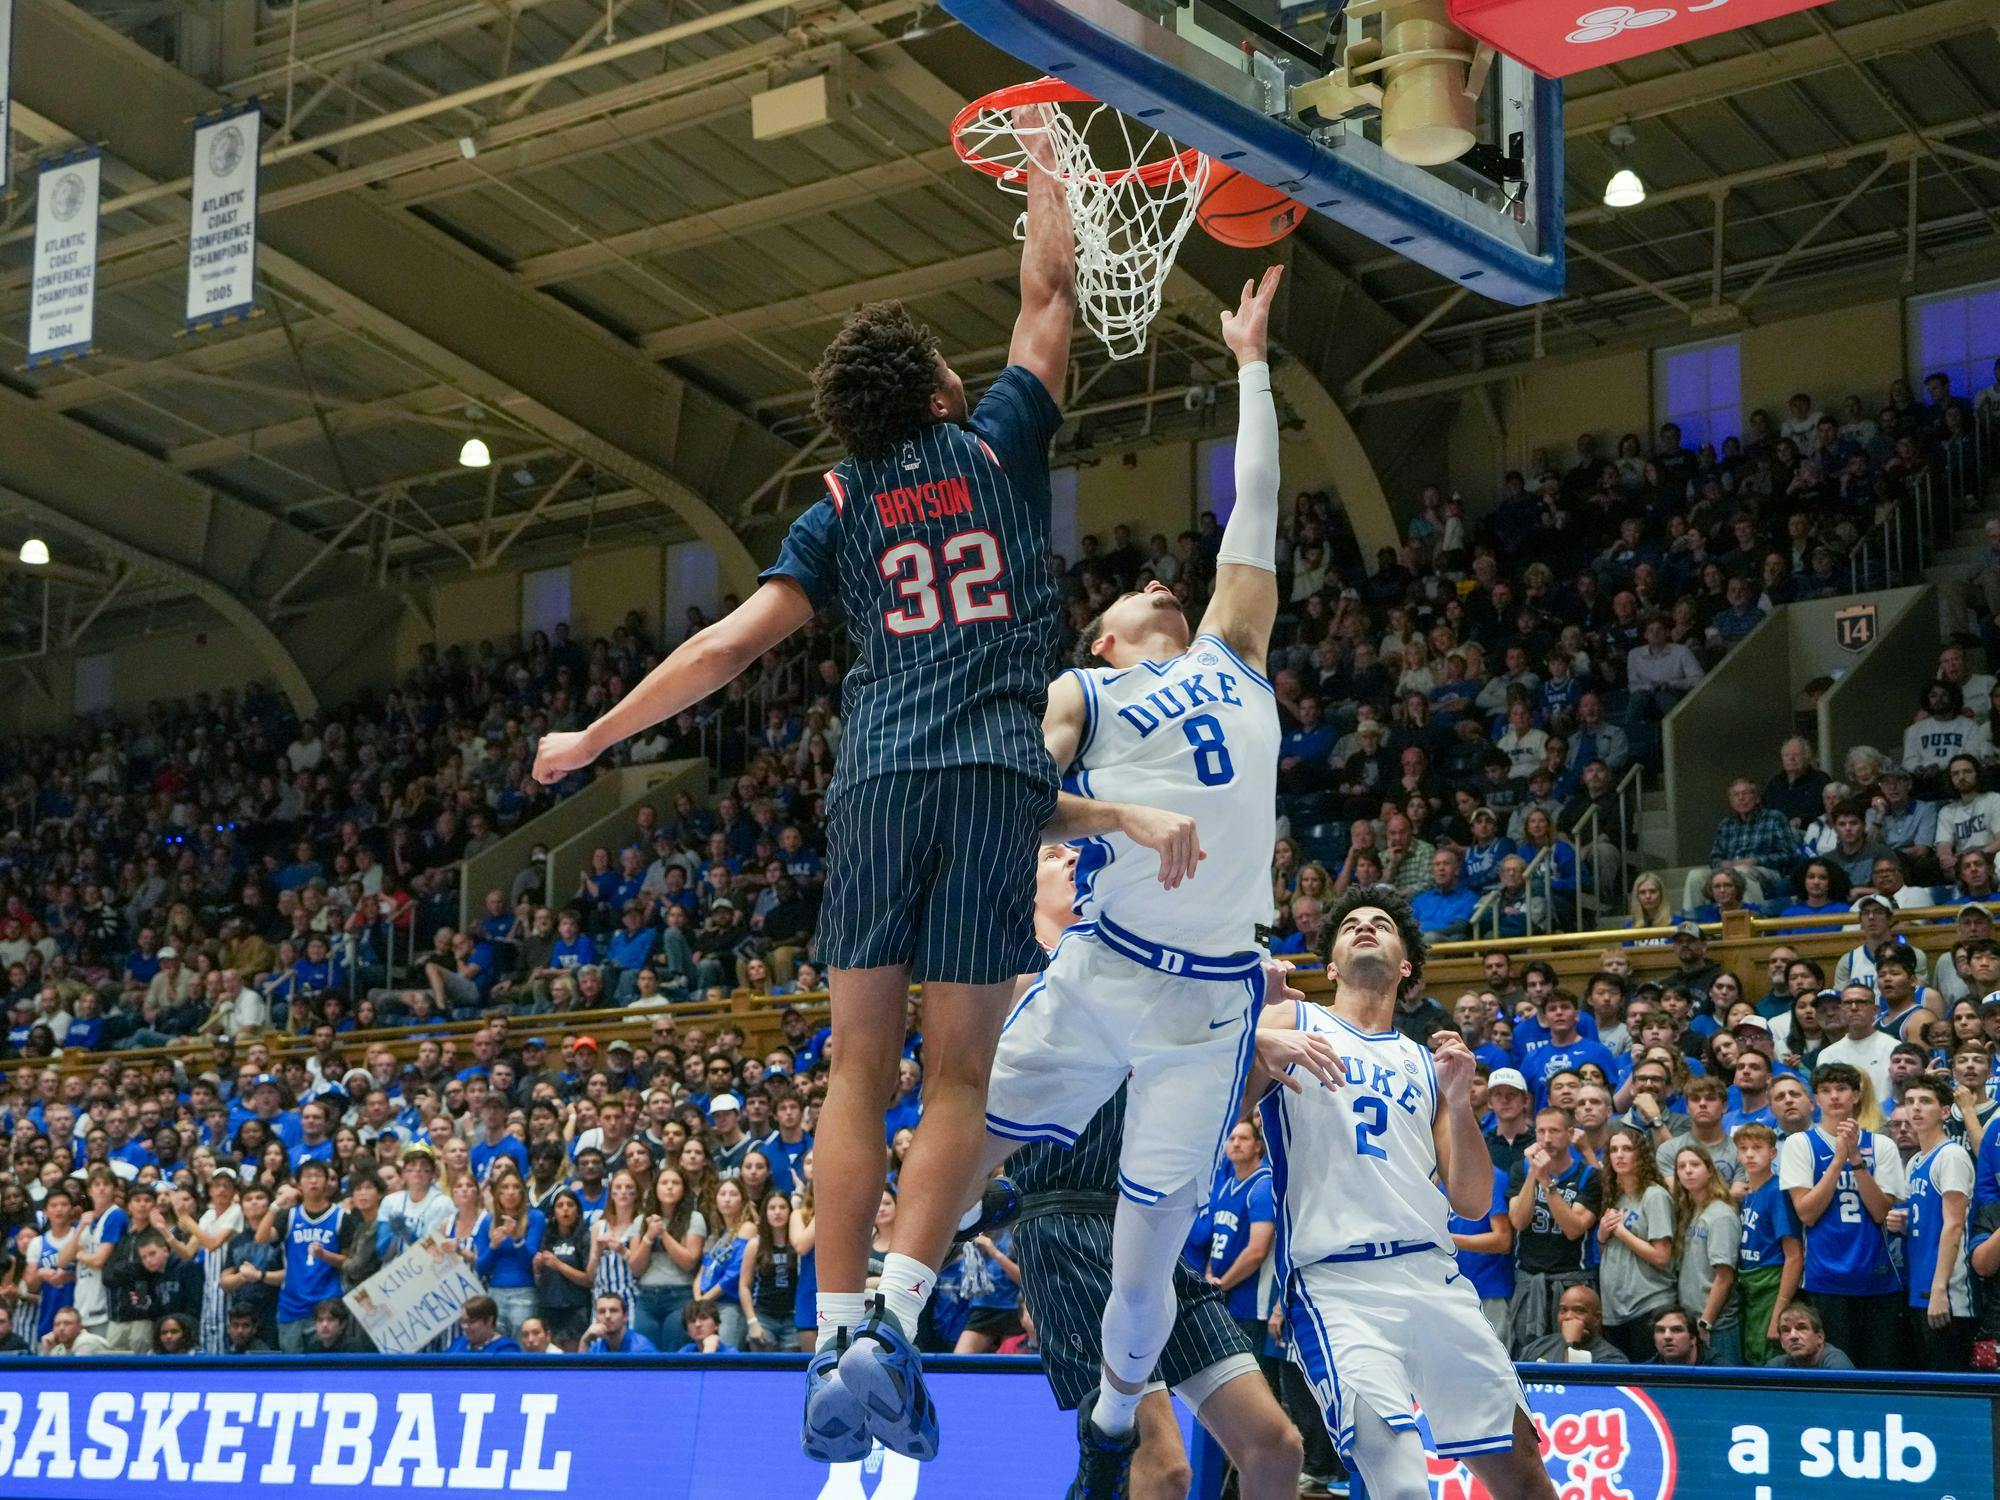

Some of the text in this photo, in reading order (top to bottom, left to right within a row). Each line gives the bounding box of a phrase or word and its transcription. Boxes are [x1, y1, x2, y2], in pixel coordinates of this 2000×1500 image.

[202, 189, 245, 213] ATLANTIC
[208, 209, 239, 230] COAST
[44, 232, 86, 254] ATLANTIC
[191, 221, 252, 252] CONFERENCE
[49, 251, 79, 269] COAST
[193, 240, 249, 268] CHAMPIONS
[35, 264, 93, 290] CONFERENCE
[37, 282, 90, 306] CHAMPIONS
[205, 284, 233, 303] 2005
[48, 323, 73, 340] 2004
[876, 476, 973, 528] BRYSON
[880, 529, 1012, 635] 32
[1842, 617, 1870, 645] 14
[1117, 671, 1243, 738] DUKE
[1182, 714, 1236, 787] 8
[1921, 732, 1963, 750] DUKE
[1320, 1056, 1422, 1115] UKE
[1352, 1095, 1388, 1161] 2
[1839, 1192, 1862, 1223] 2
[293, 1228, 334, 1244] DUKE
[378, 1257, 424, 1299] KING
[375, 1272, 479, 1353] KHAMENIA
[1728, 1413, 1938, 1483] a sub
